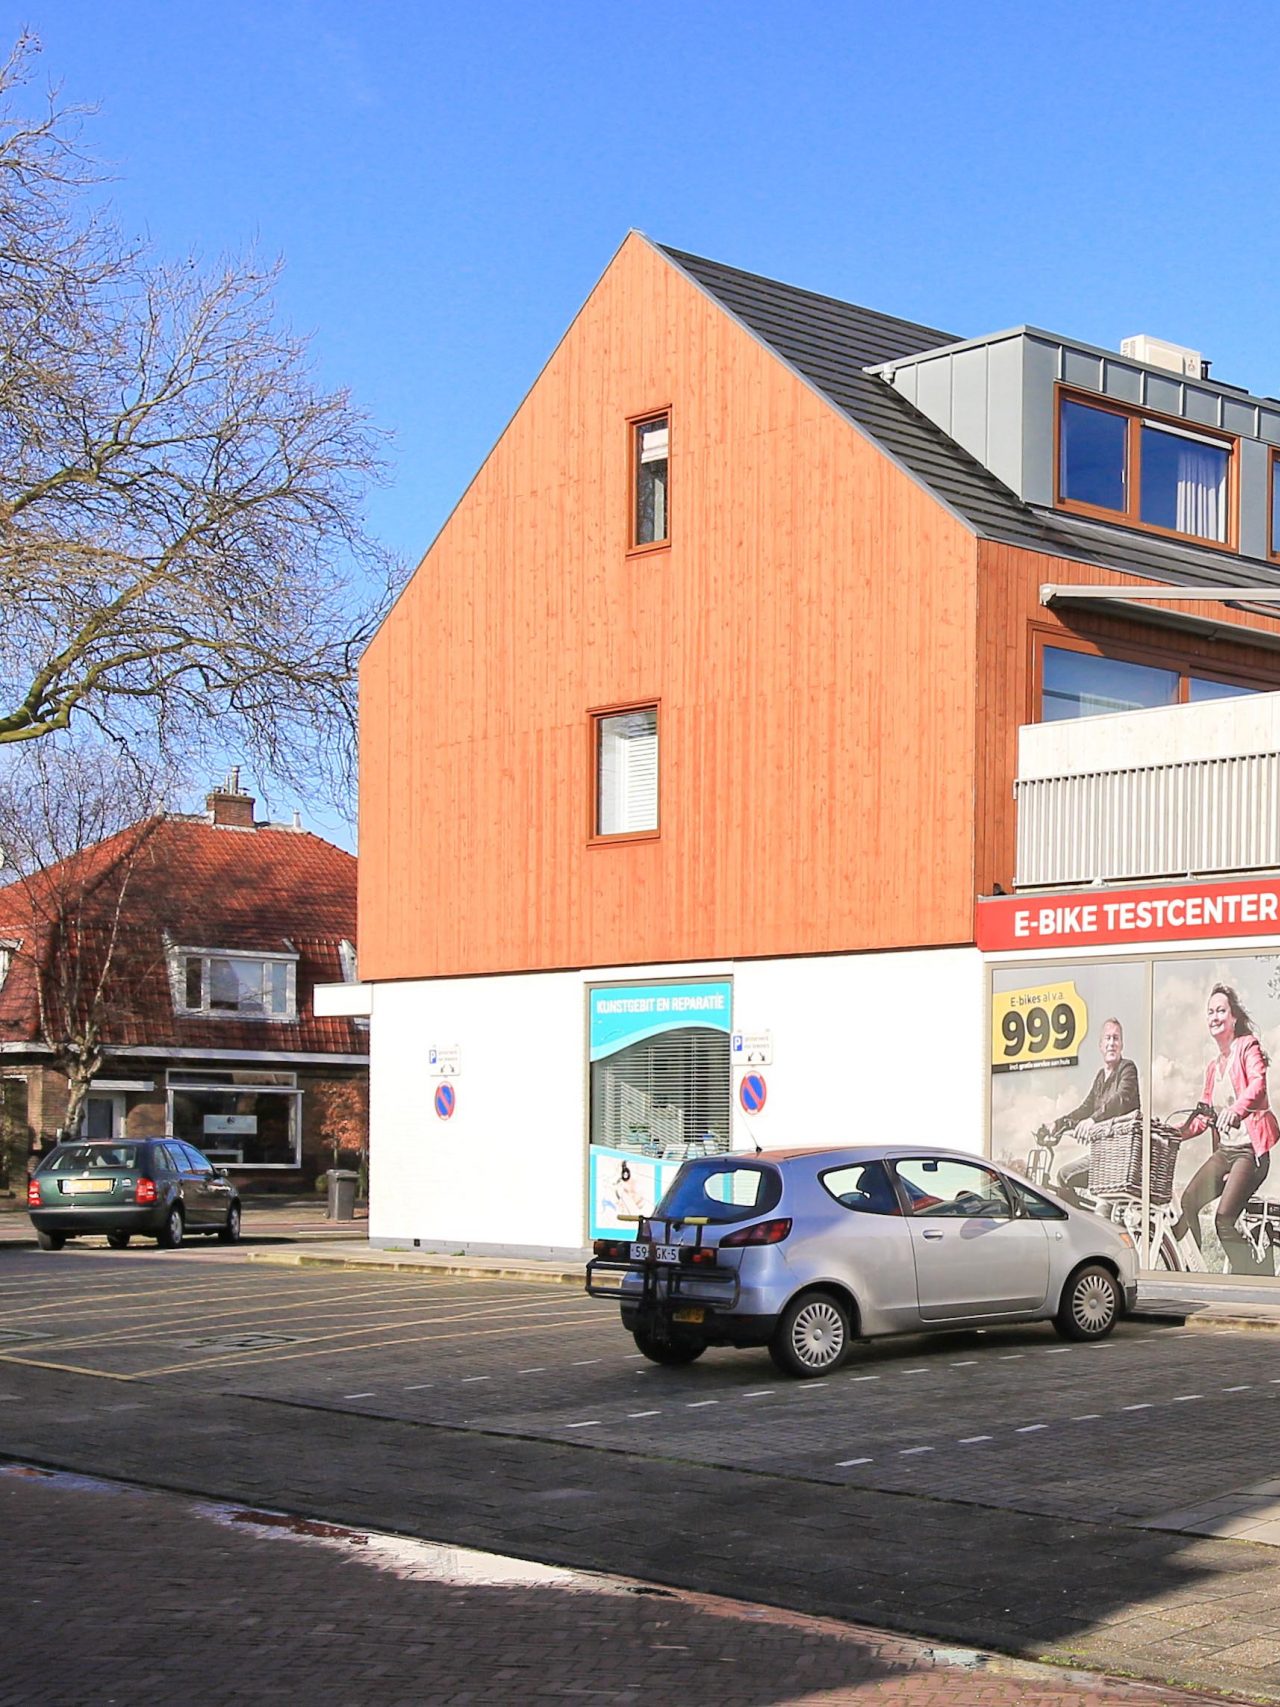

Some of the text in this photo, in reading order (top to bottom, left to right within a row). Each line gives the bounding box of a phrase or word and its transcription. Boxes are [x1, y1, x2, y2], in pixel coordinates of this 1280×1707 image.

[1014, 893, 1278, 937] E-BIKE TESTCENTER
[596, 998, 655, 1014] KUNSTGEBIT
[656, 997, 670, 1012] EN
[1010, 993, 1041, 1007] E-bikes
[1001, 1003, 1076, 1057] 999
